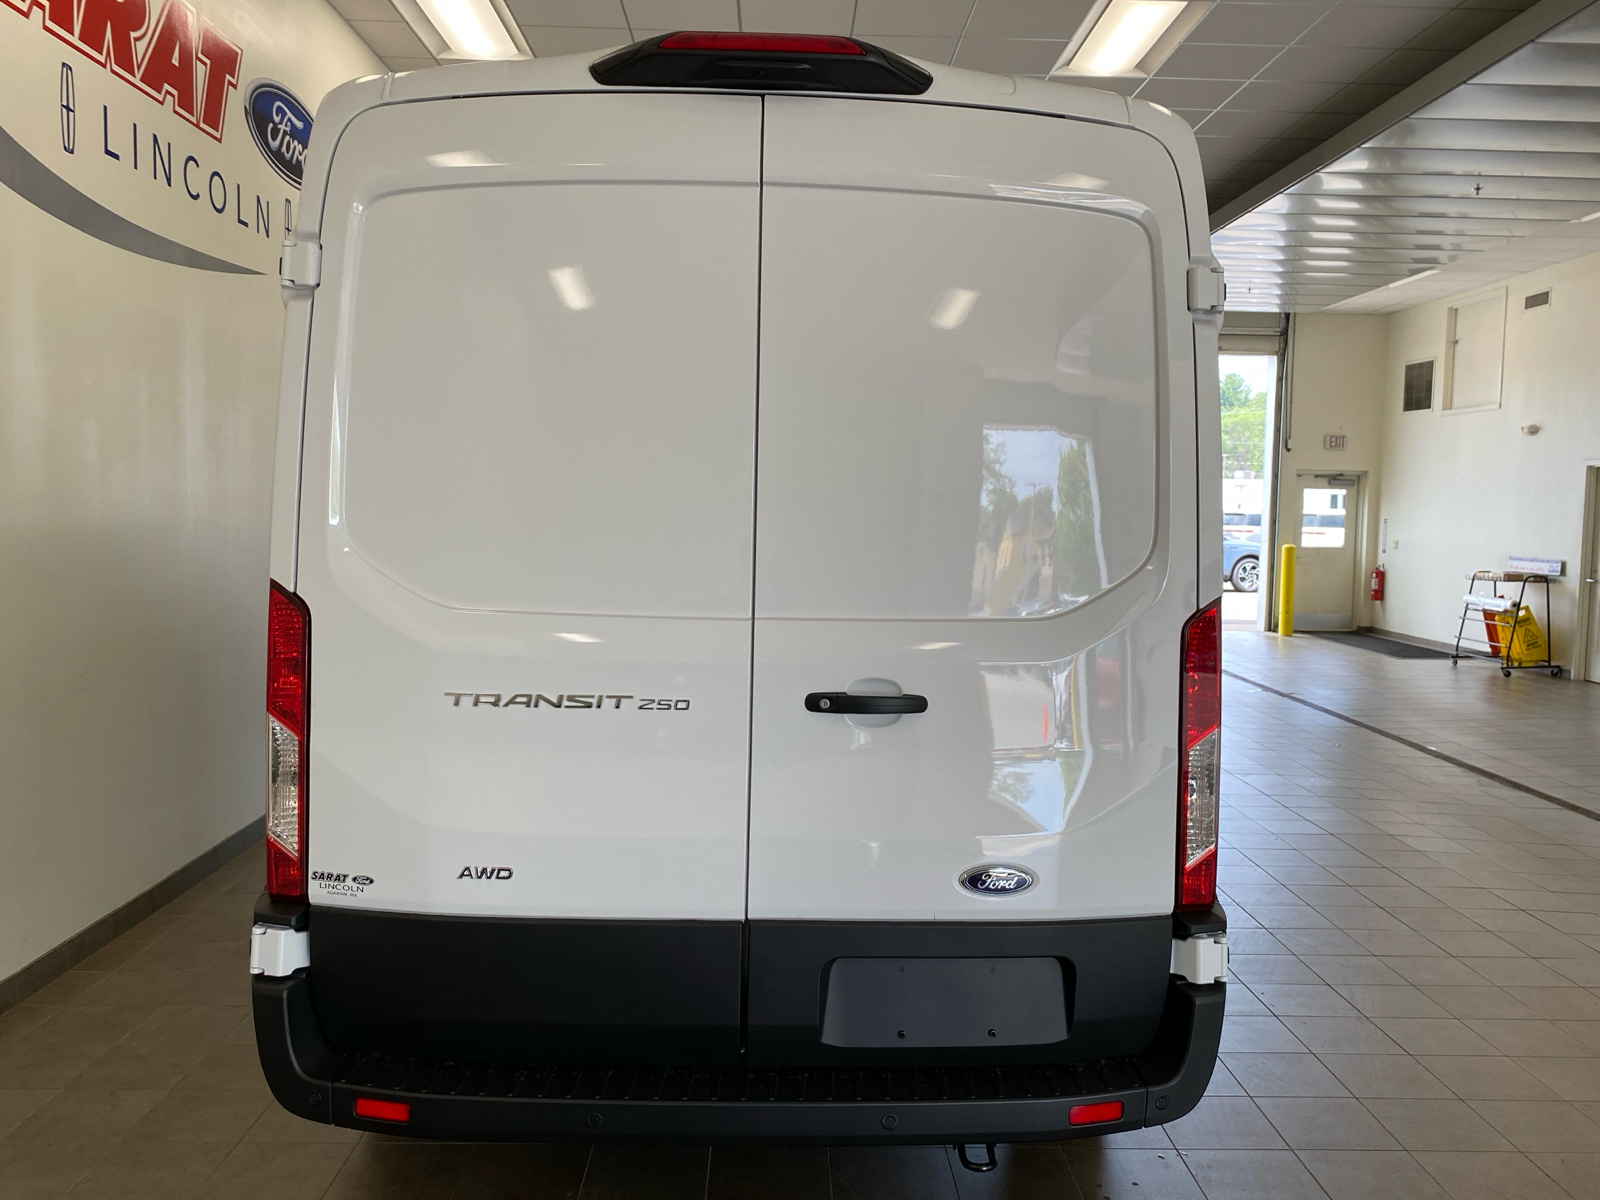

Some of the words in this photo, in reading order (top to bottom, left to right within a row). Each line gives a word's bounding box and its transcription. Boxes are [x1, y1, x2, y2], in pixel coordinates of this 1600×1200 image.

[103, 104, 270, 239] LINCOLN
[1329, 435, 1346, 449] EXIT
[444, 692, 634, 709] TRANSIT
[638, 698, 691, 711] 250
[310, 870, 349, 883] SARAT
[456, 866, 514, 881] AWD
[977, 871, 1018, 890] Ford
[319, 882, 364, 892] LINCOLN
